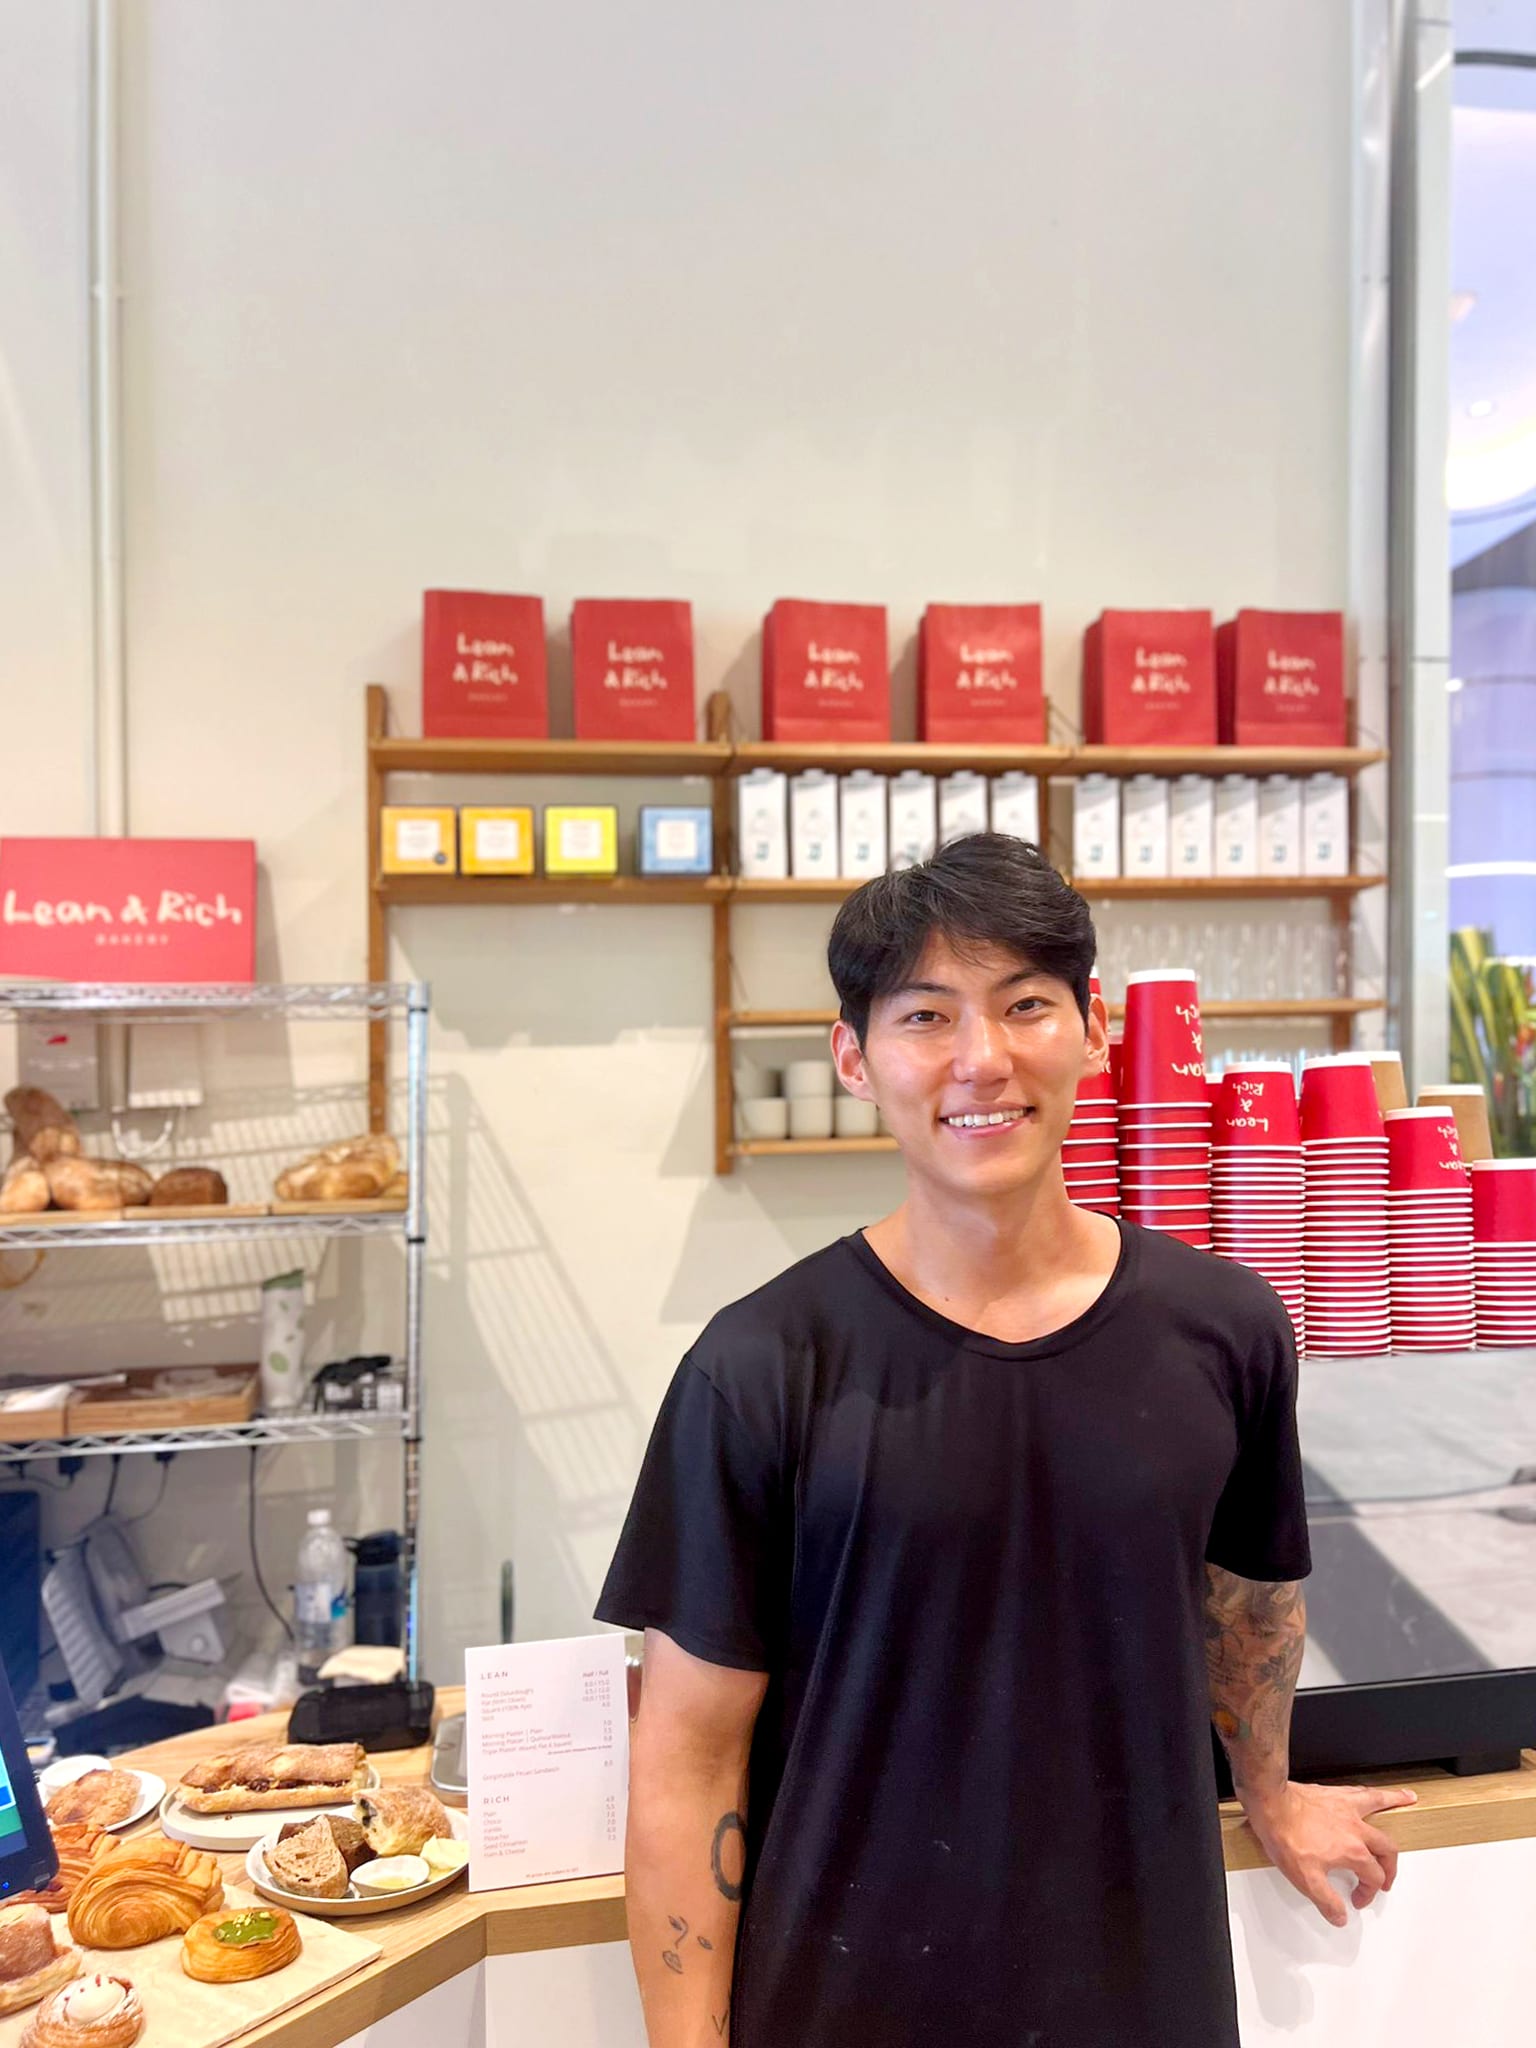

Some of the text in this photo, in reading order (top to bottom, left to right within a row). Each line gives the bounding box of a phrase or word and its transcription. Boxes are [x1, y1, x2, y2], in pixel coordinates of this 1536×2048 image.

[457, 632, 515, 657] Lean
[608, 640, 663, 662] Lean
[808, 641, 860, 664] Lean
[960, 642, 1014, 664] Lean
[1135, 647, 1187, 669] Lean
[1267, 649, 1316, 671] Lean
[3, 889, 113, 927] Lean
[156, 889, 243, 928] Rich
[1232, 1081, 1265, 1096] Rich
[1226, 1117, 1270, 1132] Lean
[480, 1671, 509, 1680] LEAN
[483, 1795, 510, 1804] RICH
